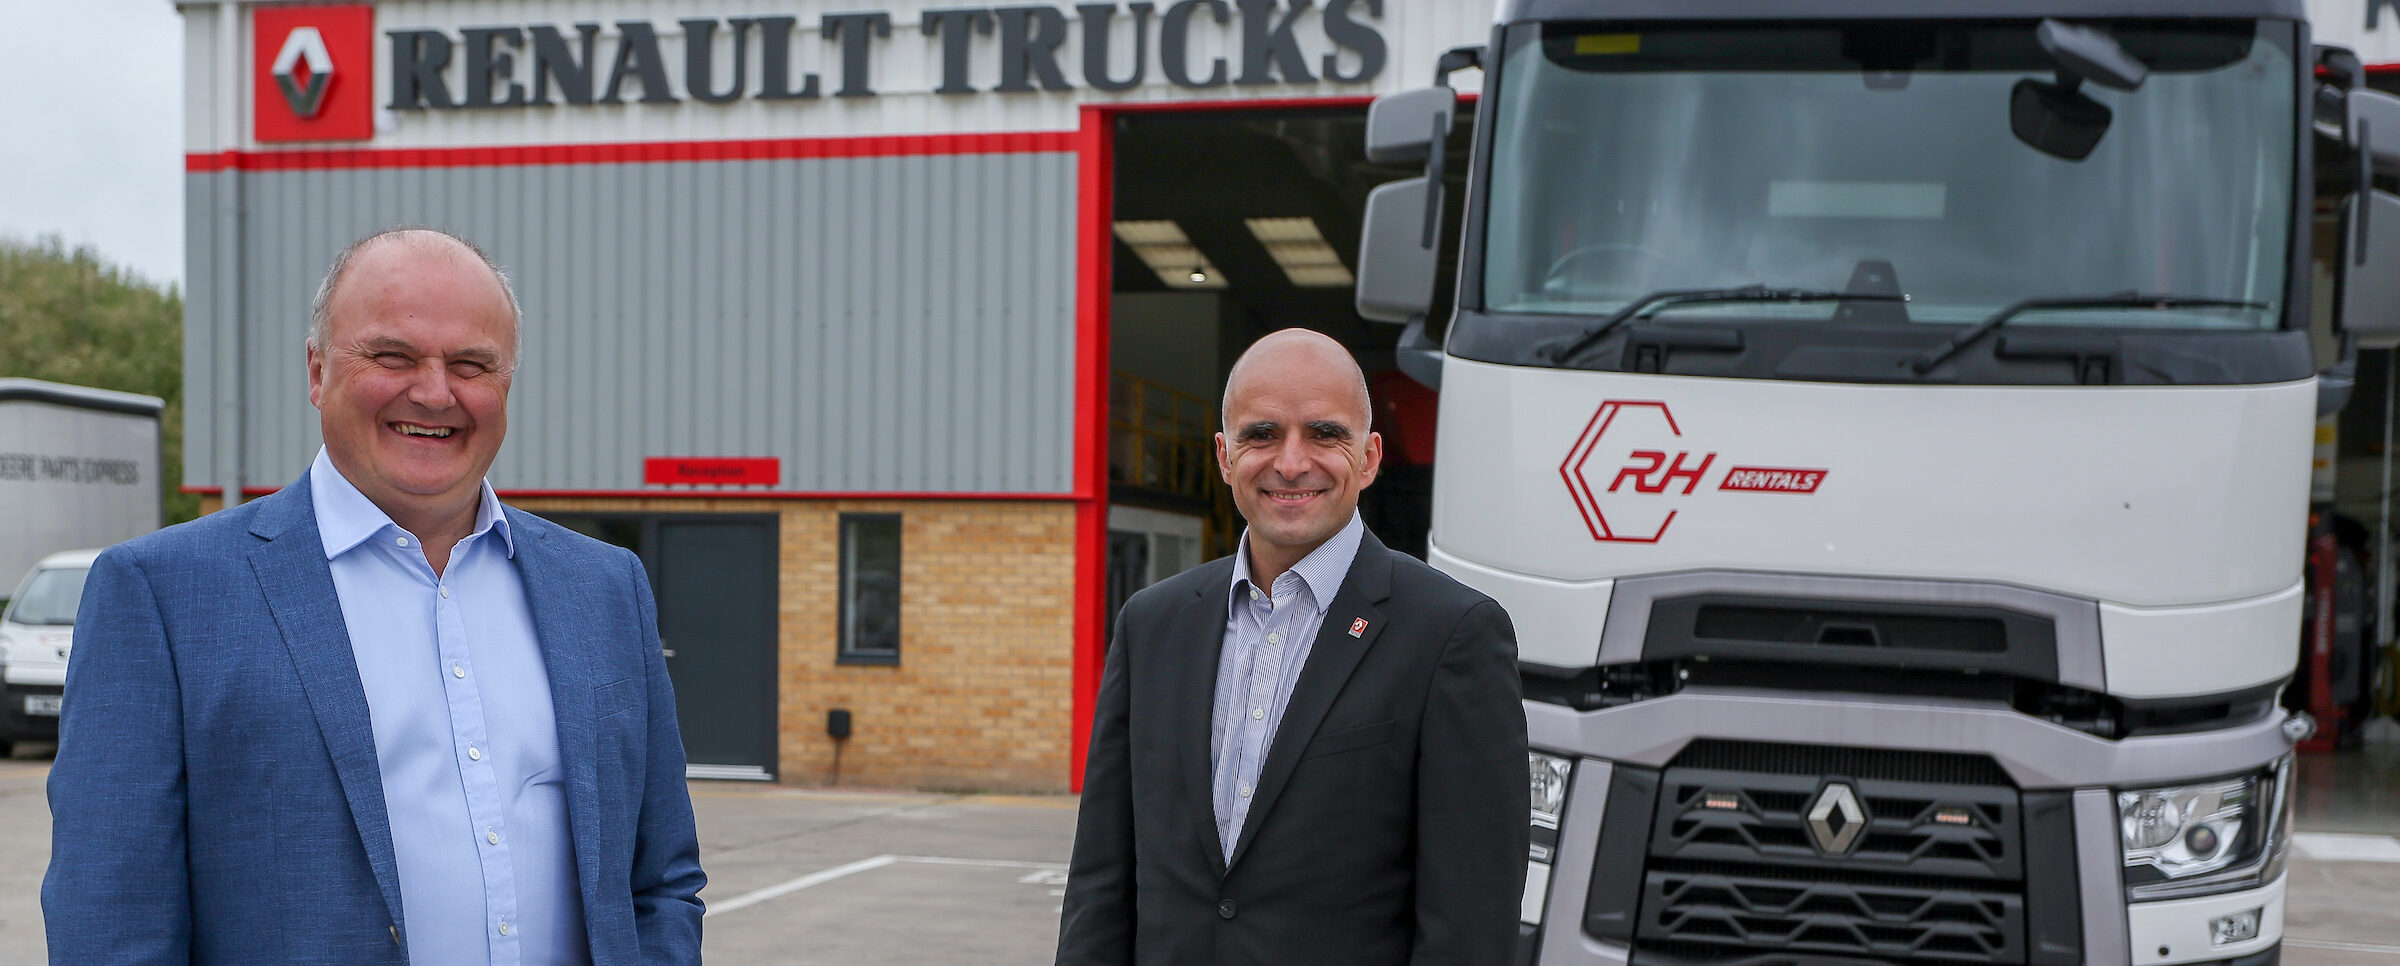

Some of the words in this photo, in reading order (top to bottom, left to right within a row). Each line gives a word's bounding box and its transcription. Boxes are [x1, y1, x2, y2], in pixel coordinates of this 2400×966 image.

[386, 12, 891, 111] RENAULT
[922, 0, 1388, 95] TRUCKS
[40, 455, 80, 483] PARTS
[83, 457, 139, 486] EXPRESS
[678, 462, 746, 478] Reception
[1608, 450, 1717, 495] RH
[1728, 469, 1818, 490] RENTALS
